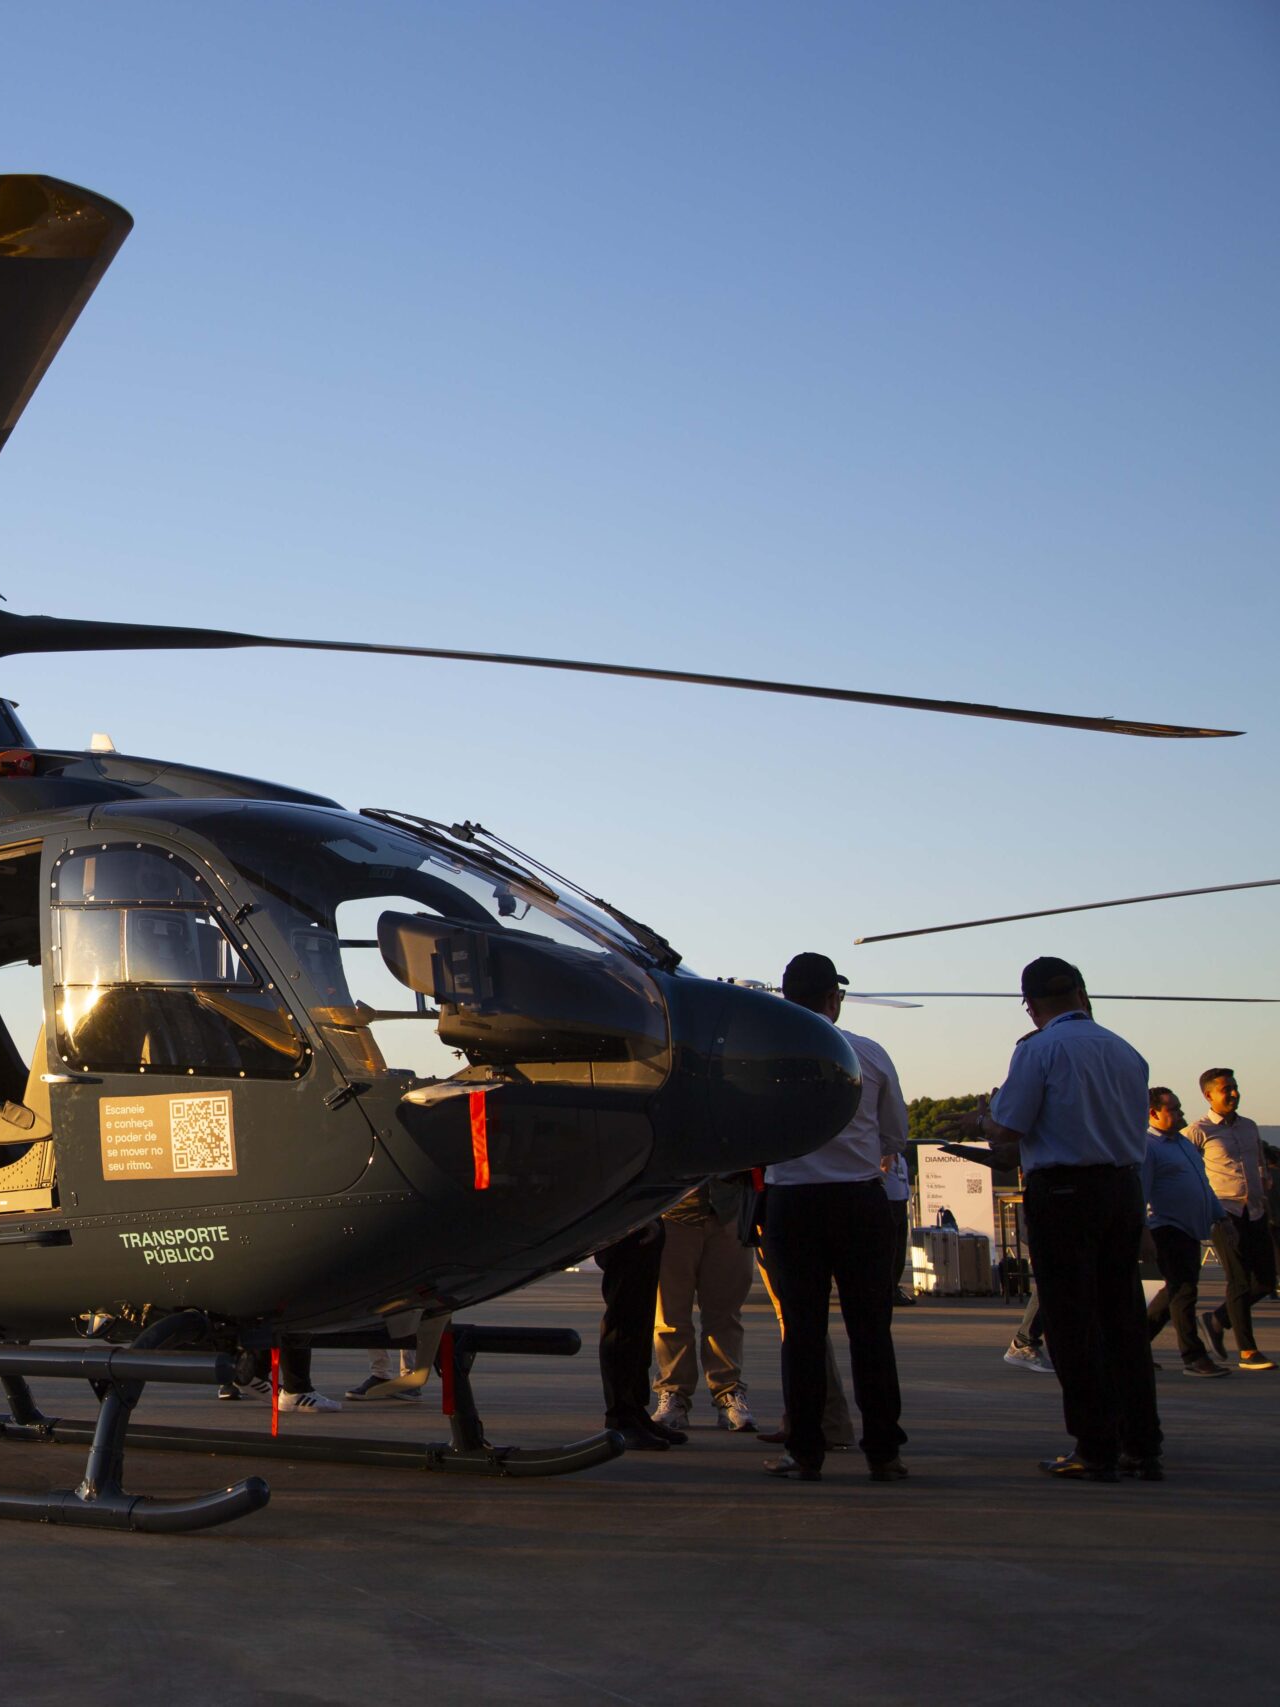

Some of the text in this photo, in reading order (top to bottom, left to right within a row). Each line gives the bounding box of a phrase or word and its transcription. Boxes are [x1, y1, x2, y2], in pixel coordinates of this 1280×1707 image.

[105, 1104, 145, 1115] Escaneie
[106, 1118, 154, 1130] e conheça
[107, 1131, 157, 1144] o poder de
[107, 1146, 164, 1157] se mover no
[108, 1160, 153, 1171] seu ritmo.
[119, 1226, 230, 1249] TRANSPORTE
[143, 1245, 215, 1265] PÚBLICO
